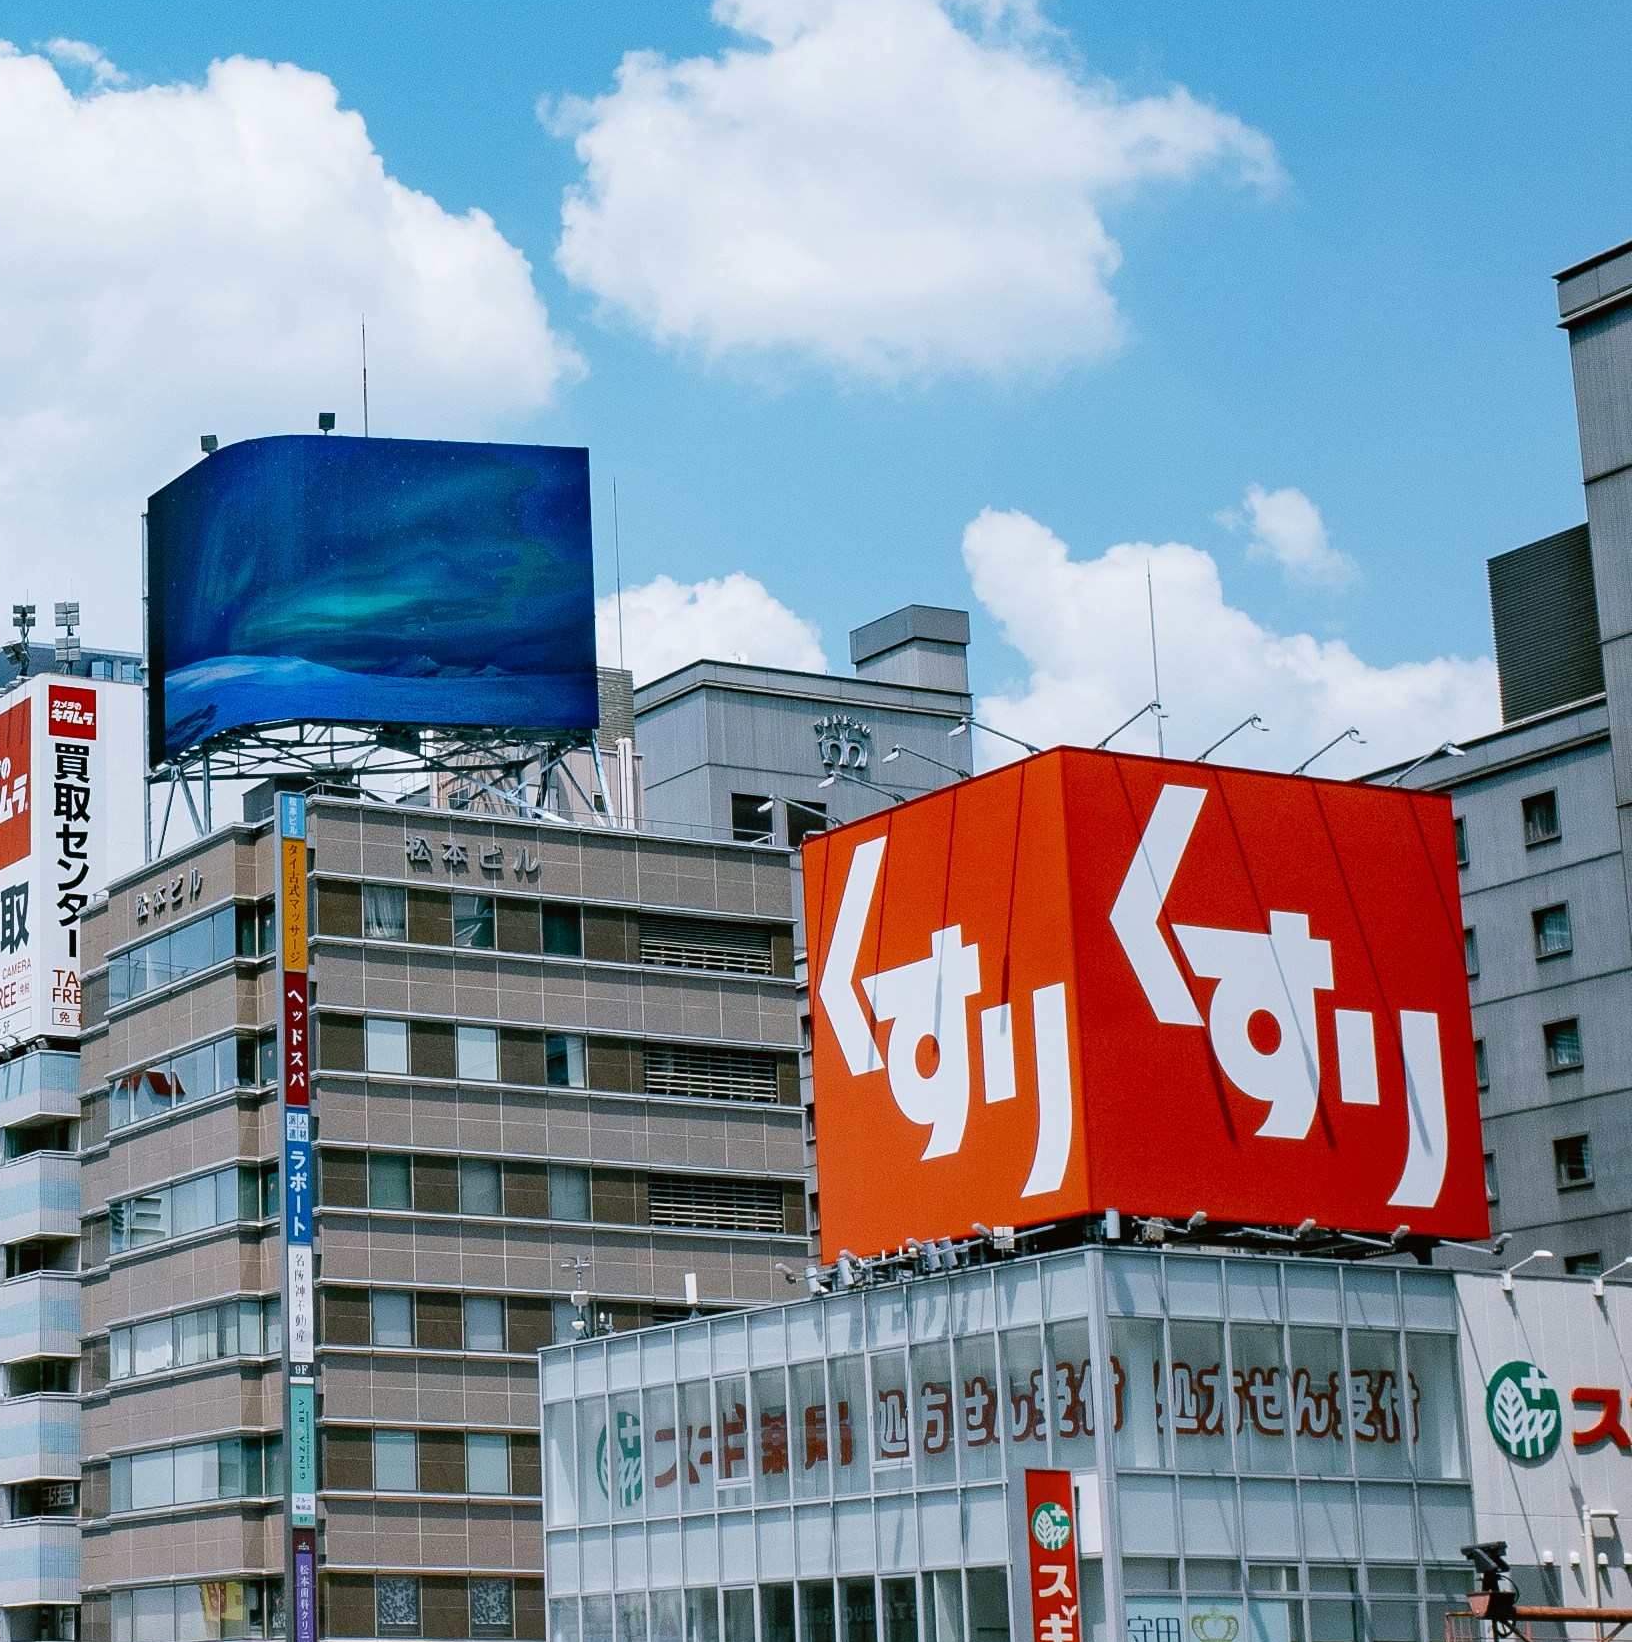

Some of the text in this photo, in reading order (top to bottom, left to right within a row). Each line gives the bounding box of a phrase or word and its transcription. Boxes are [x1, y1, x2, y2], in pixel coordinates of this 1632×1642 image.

[51, 708, 94, 725] キタムラ
[52, 699, 82, 711] カメラの
[53, 742, 91, 959] 買取センター
[405, 833, 542, 873] 松本ビル
[135, 866, 203, 919] 松本ビル
[287, 843, 301, 964] タイ古式マッサージ
[2, 958, 32, 981] CAMERA
[52, 988, 81, 1005] FRE
[1109, 784, 1449, 1209] くすり
[287, 989, 305, 1088] ヘッドスパ
[819, 835, 1072, 1198] くすり
[289, 1149, 307, 1237] ラポート
[294, 1364, 309, 1376] 9F
[1154, 1362, 1420, 1444] 処方せん受付
